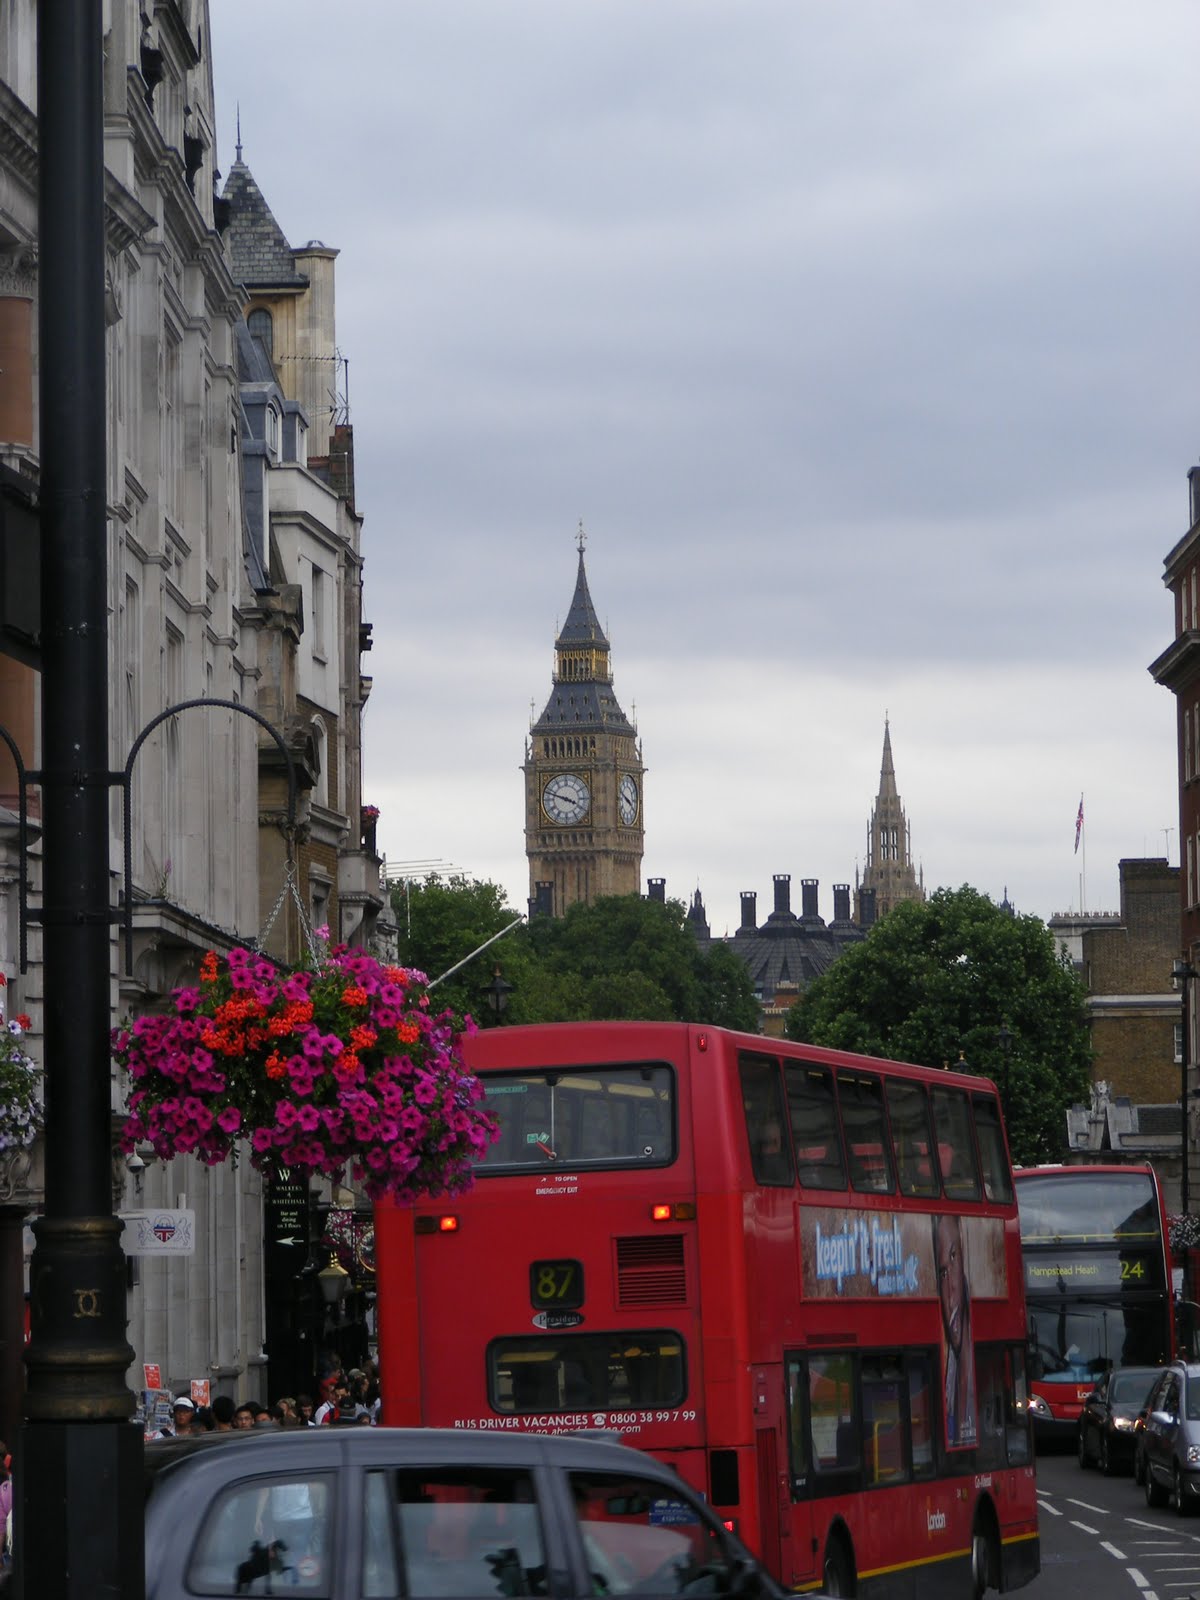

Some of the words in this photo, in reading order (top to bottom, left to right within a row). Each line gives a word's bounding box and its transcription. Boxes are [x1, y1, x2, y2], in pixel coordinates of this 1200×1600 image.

[278, 1168, 290, 1181] W
[535, 1187, 567, 1195] EMERGENCY
[567, 1186, 578, 1194] EXIT
[859, 1217, 870, 1275] it
[871, 1215, 902, 1286] fresh
[1029, 1266, 1073, 1278] Hampstead
[1075, 1265, 1099, 1275] Heath
[1120, 1261, 1144, 1279] 24
[537, 1266, 575, 1298] 87
[539, 1314, 580, 1325] President
[455, 1419, 477, 1429] BUS
[480, 1418, 520, 1429] DRIVER
[523, 1415, 588, 1427] VACANCIES
[610, 1413, 637, 1424] 0800
[640, 1412, 653, 1422] 38
[656, 1411, 670, 1422] 99
[673, 1411, 679, 1421] 7
[682, 1410, 696, 1421] 99
[927, 1509, 946, 1531] London
